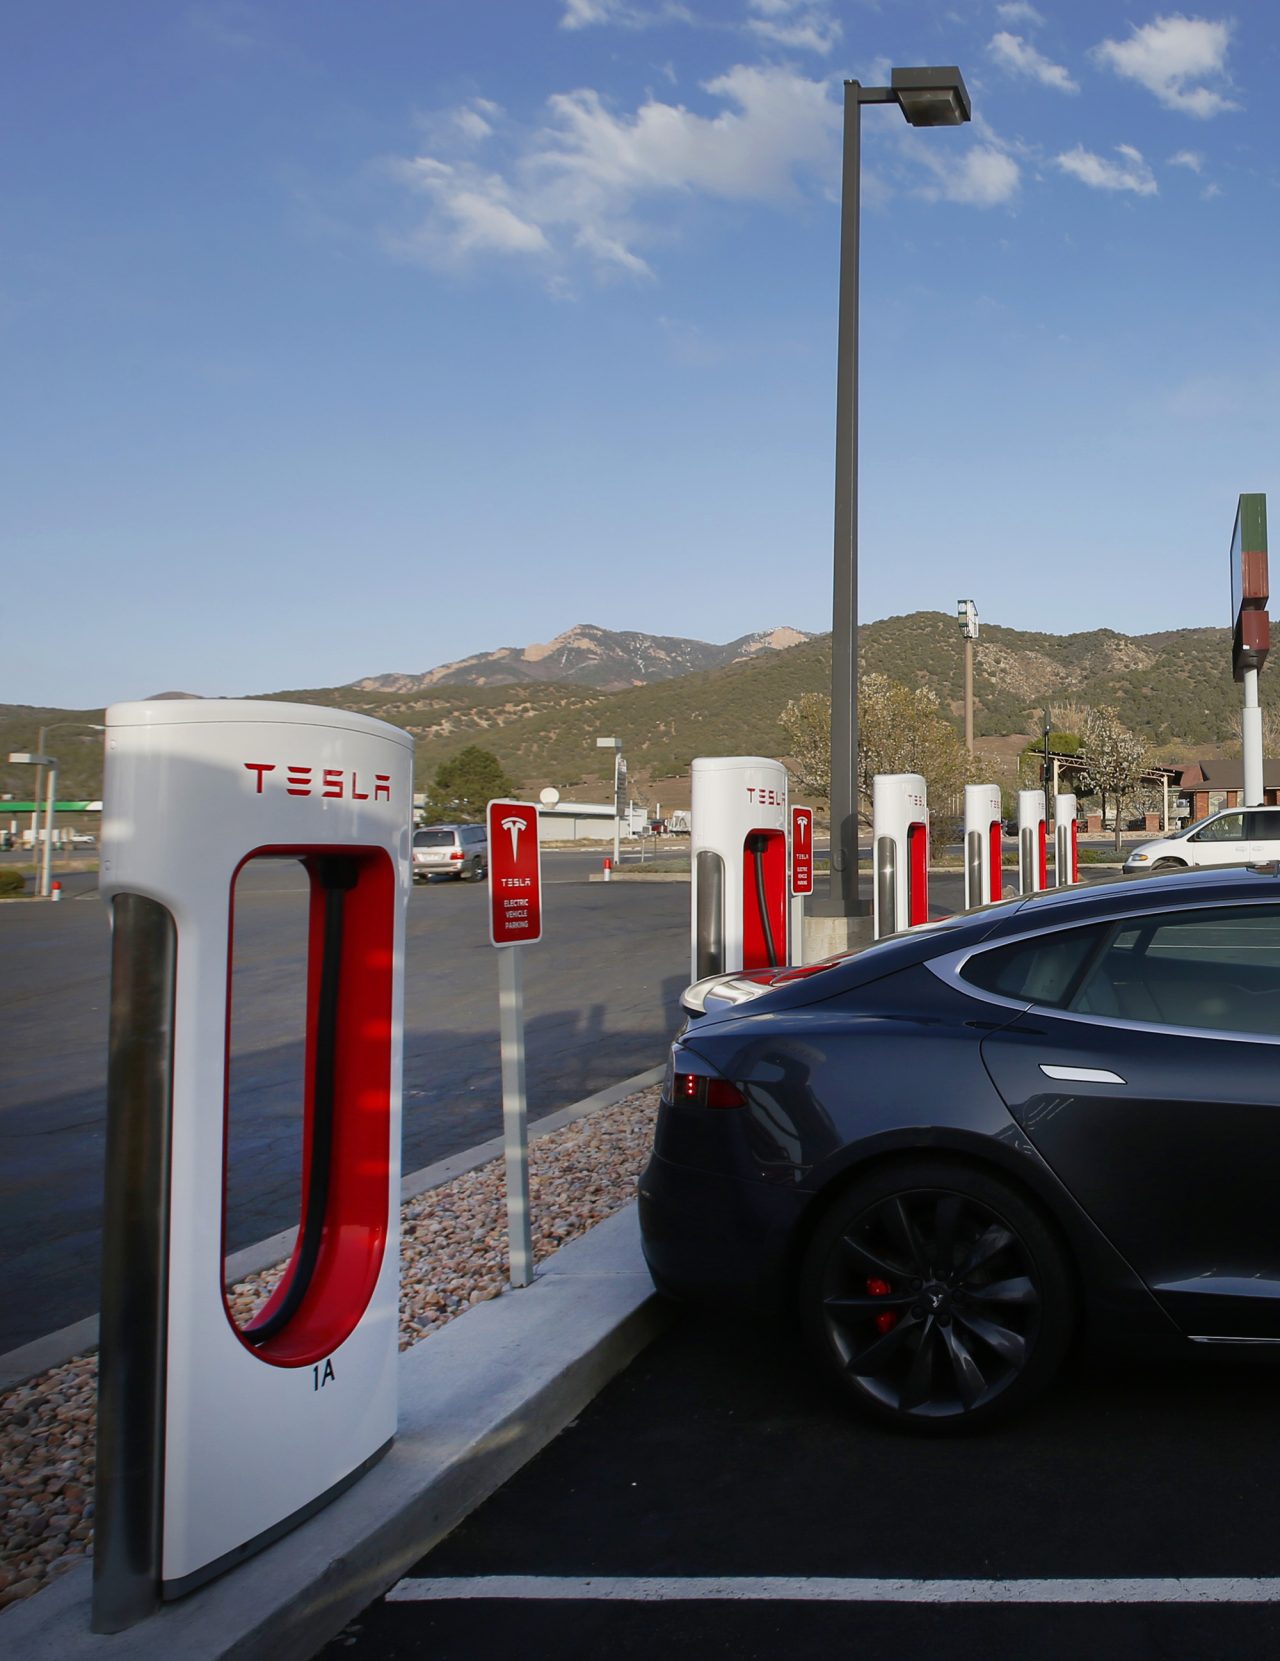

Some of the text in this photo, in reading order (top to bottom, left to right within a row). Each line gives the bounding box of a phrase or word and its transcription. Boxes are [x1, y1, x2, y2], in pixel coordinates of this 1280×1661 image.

[243, 762, 391, 802] TESLA
[500, 878, 531, 887] TESLA
[503, 898, 529, 908] ELECTRIC
[313, 1358, 336, 1392] 1A
